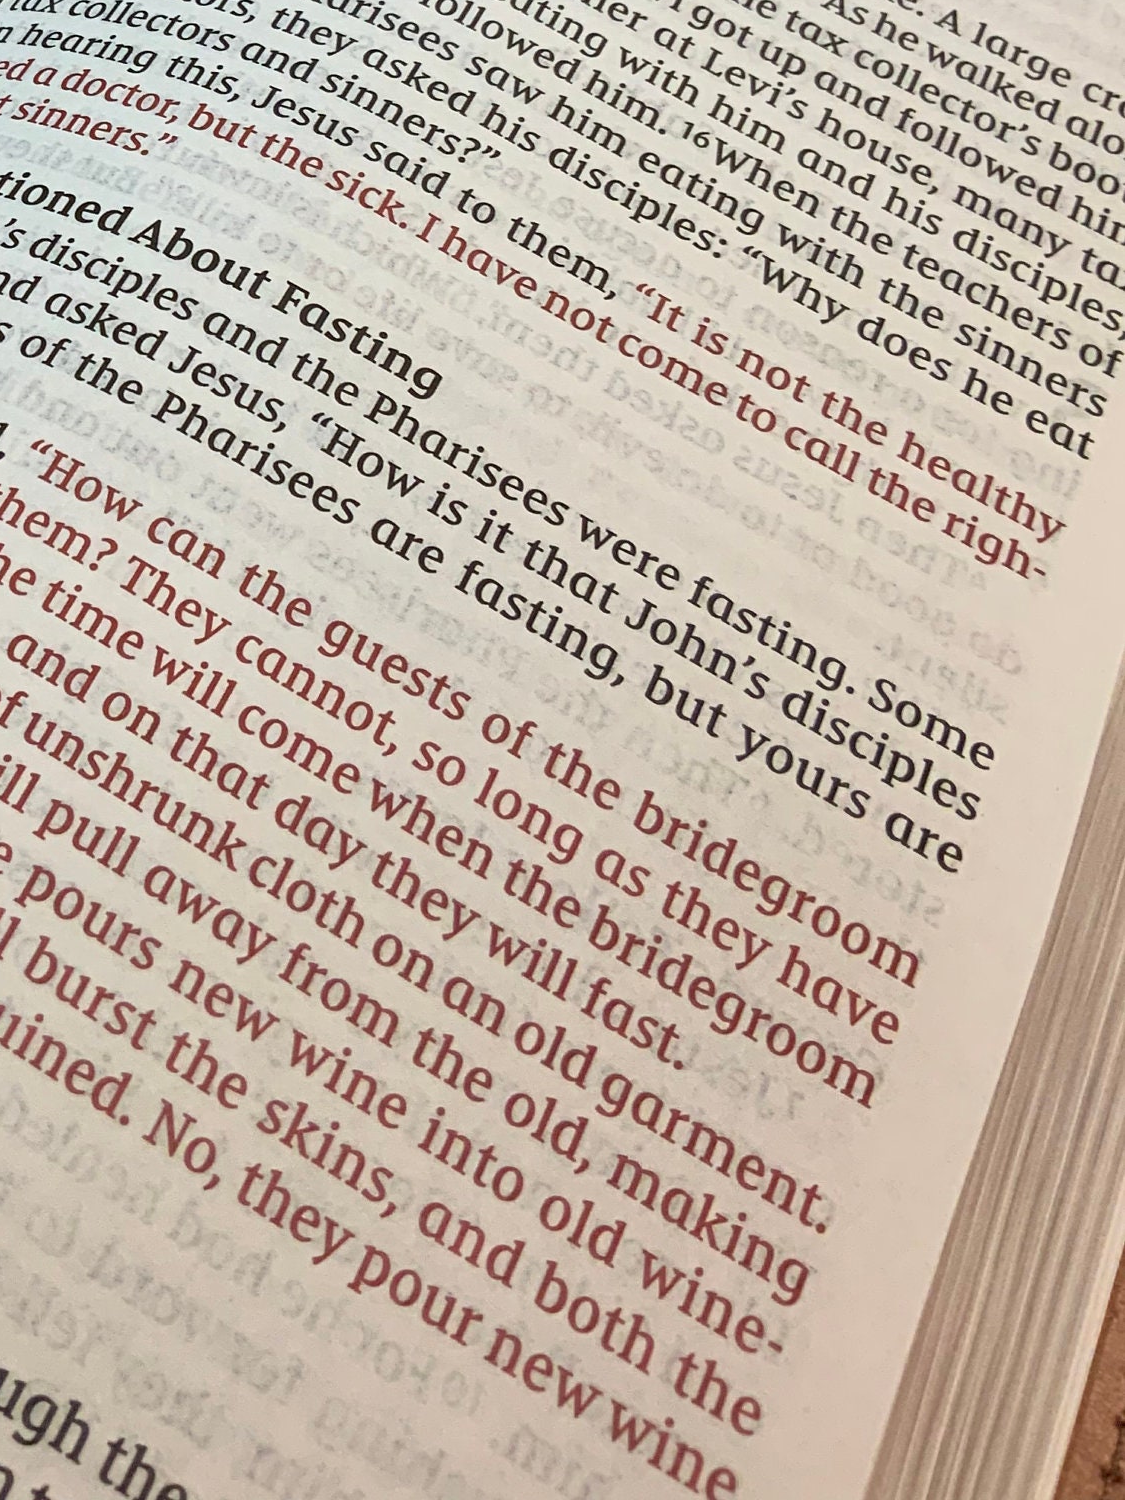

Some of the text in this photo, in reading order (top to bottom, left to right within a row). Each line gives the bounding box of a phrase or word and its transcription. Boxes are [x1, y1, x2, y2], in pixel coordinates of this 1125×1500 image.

[10, 97, 179, 157] sinners.”
[127, 218, 272, 300] About
[270, 279, 444, 401] Fasting
[581, 68, 667, 136] him.
[830, 205, 894, 256] the
[902, 243, 1072, 351] teachers
[1078, 343, 1125, 379] of
[30, 439, 144, 523] “How
[146, 516, 226, 580] can
[238, 563, 313, 628] the
[317, 619, 472, 721] guests
[481, 713, 539, 760] of
[543, 742, 622, 811] the
[633, 789, 920, 990] bridegroom
[44, 292, 169, 362] asked
[166, 344, 287, 434] Jesus,
[311, 412, 426, 498] “How
[426, 481, 469, 526] is
[473, 509, 515, 554] it
[522, 539, 620, 615] that
[623, 598, 771, 701] John’s
[781, 689, 982, 821] disciples
[119, 554, 233, 646] They
[235, 634, 398, 757] cannot,
[410, 740, 467, 787] so
[473, 767, 584, 866] long
[594, 848, 652, 898] as
[661, 880, 774, 972] they
[776, 944, 900, 1046] have
